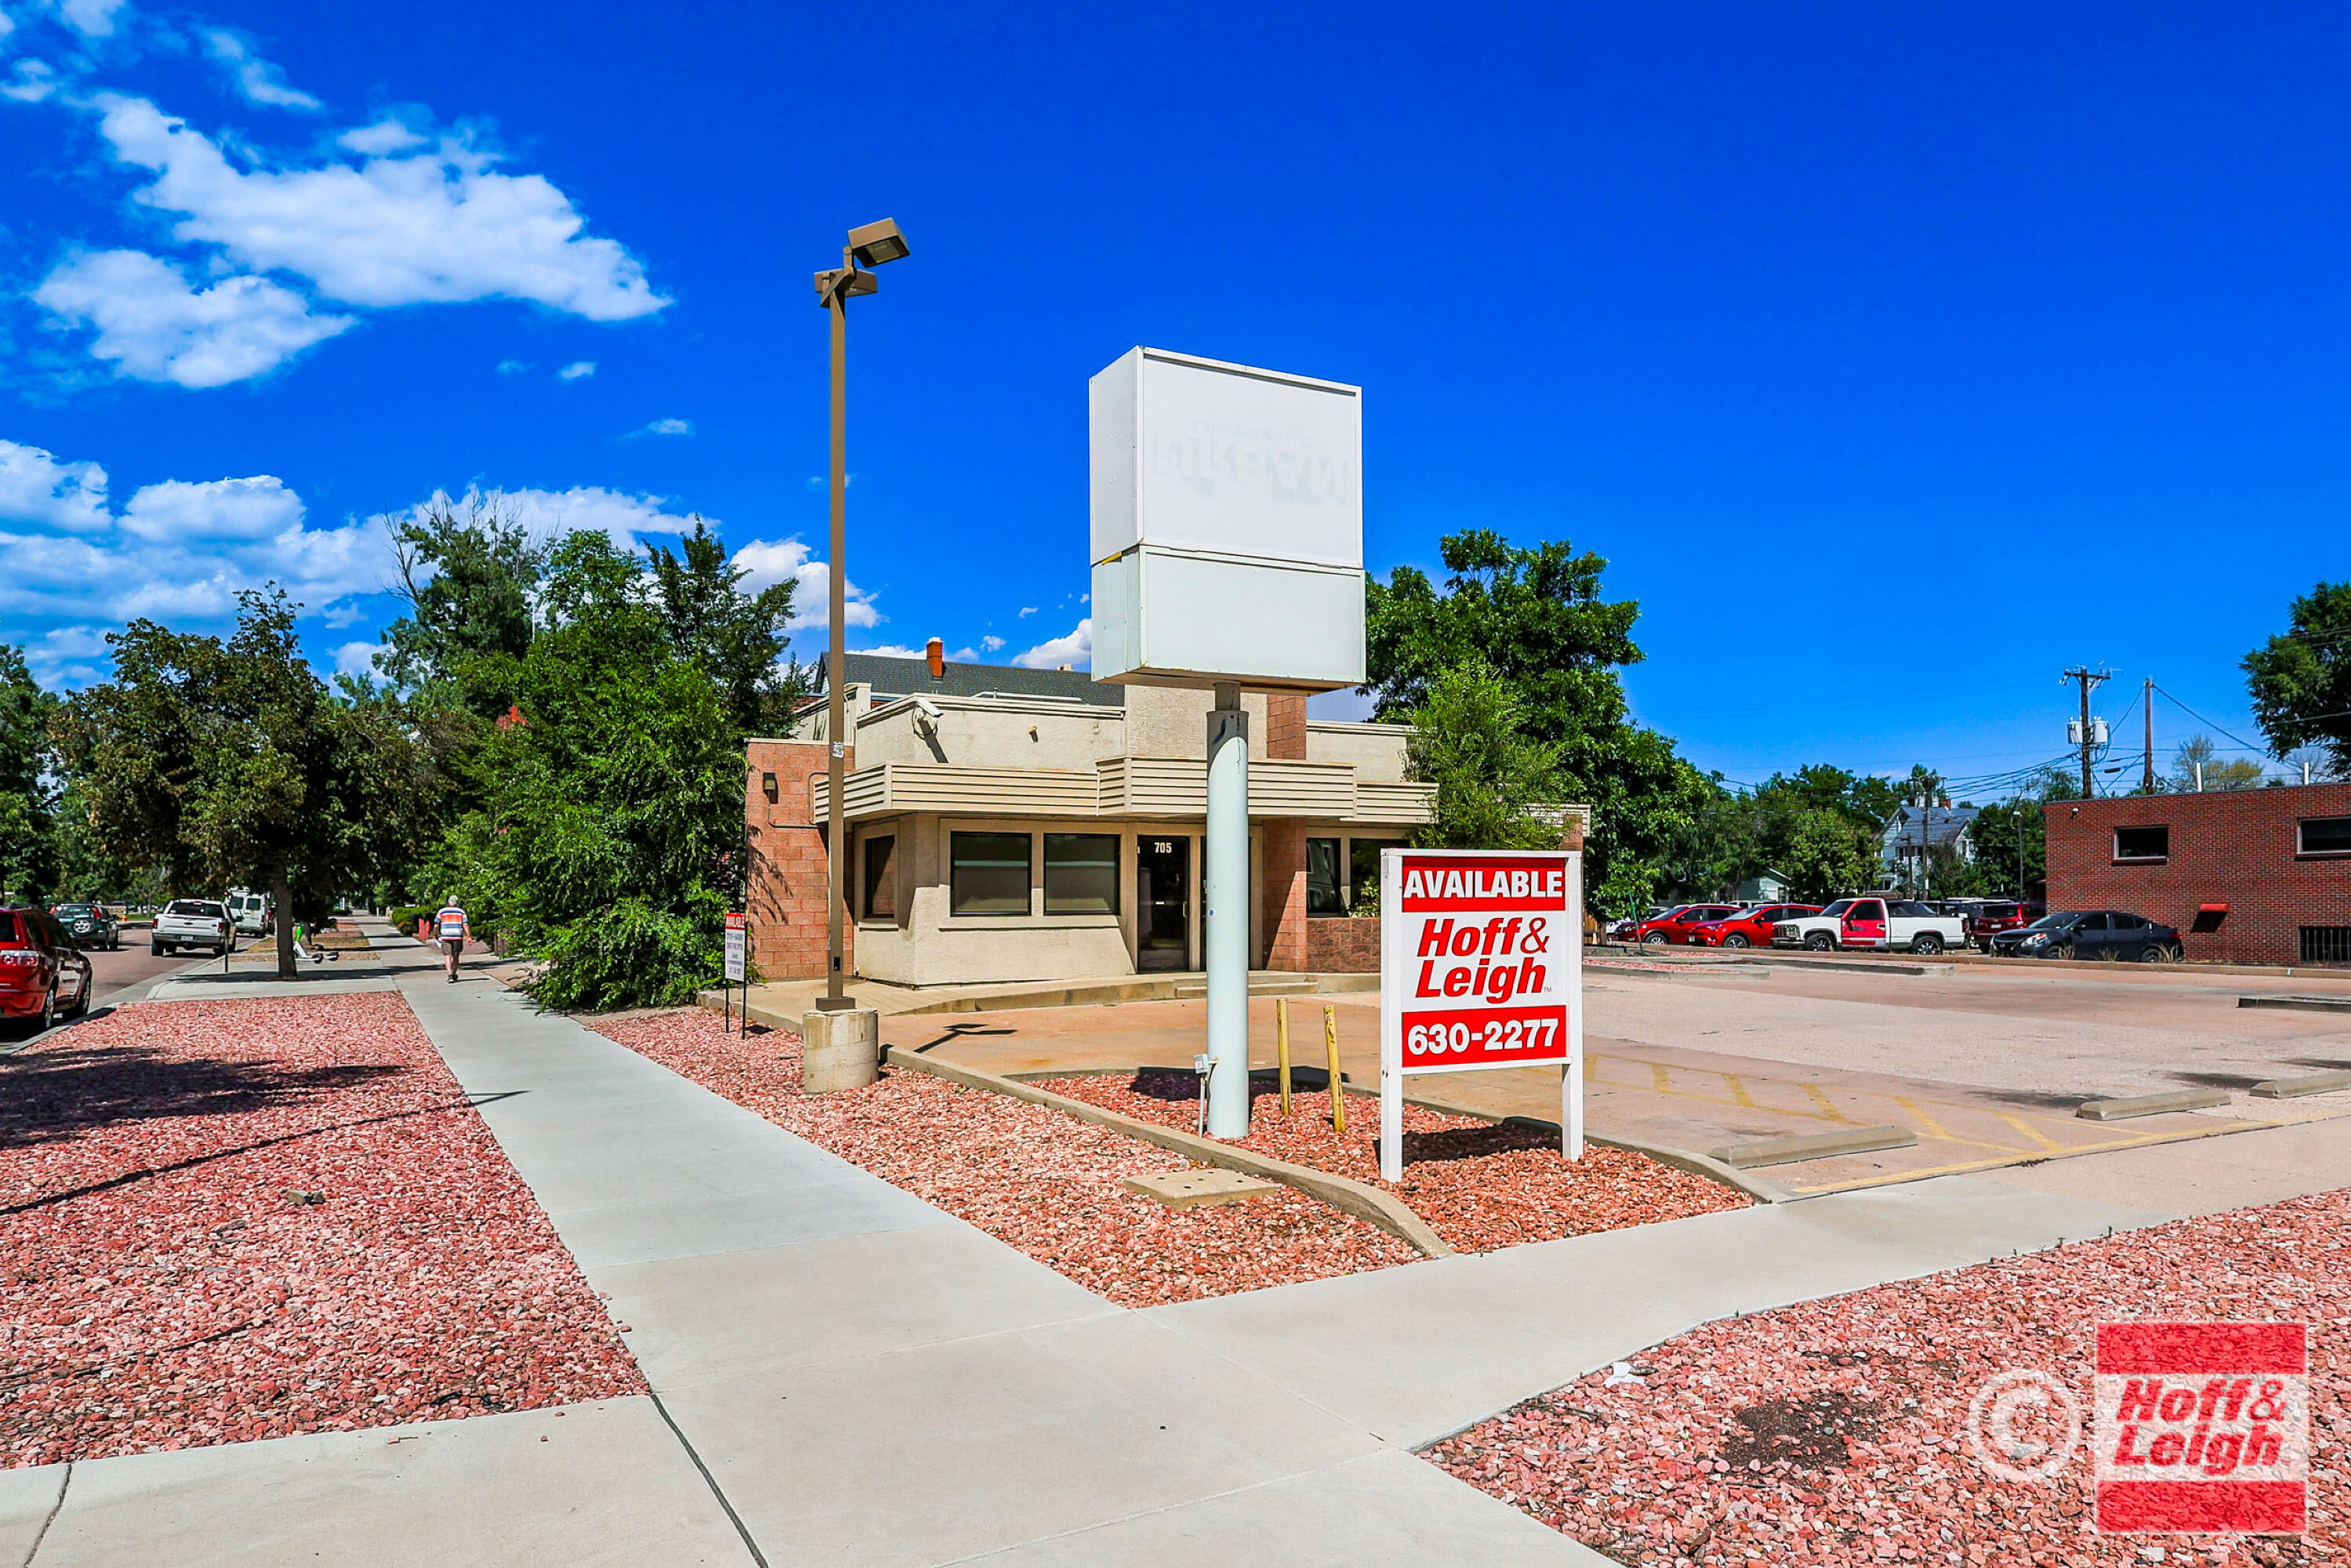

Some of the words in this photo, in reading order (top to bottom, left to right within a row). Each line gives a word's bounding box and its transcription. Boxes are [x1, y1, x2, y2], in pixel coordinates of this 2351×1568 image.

[1154, 842, 1172, 854] 705
[1403, 869, 1563, 899] AVAILABLE
[1415, 956, 1547, 1004] Leigh
[1407, 1018, 1559, 1056] 630-2277
